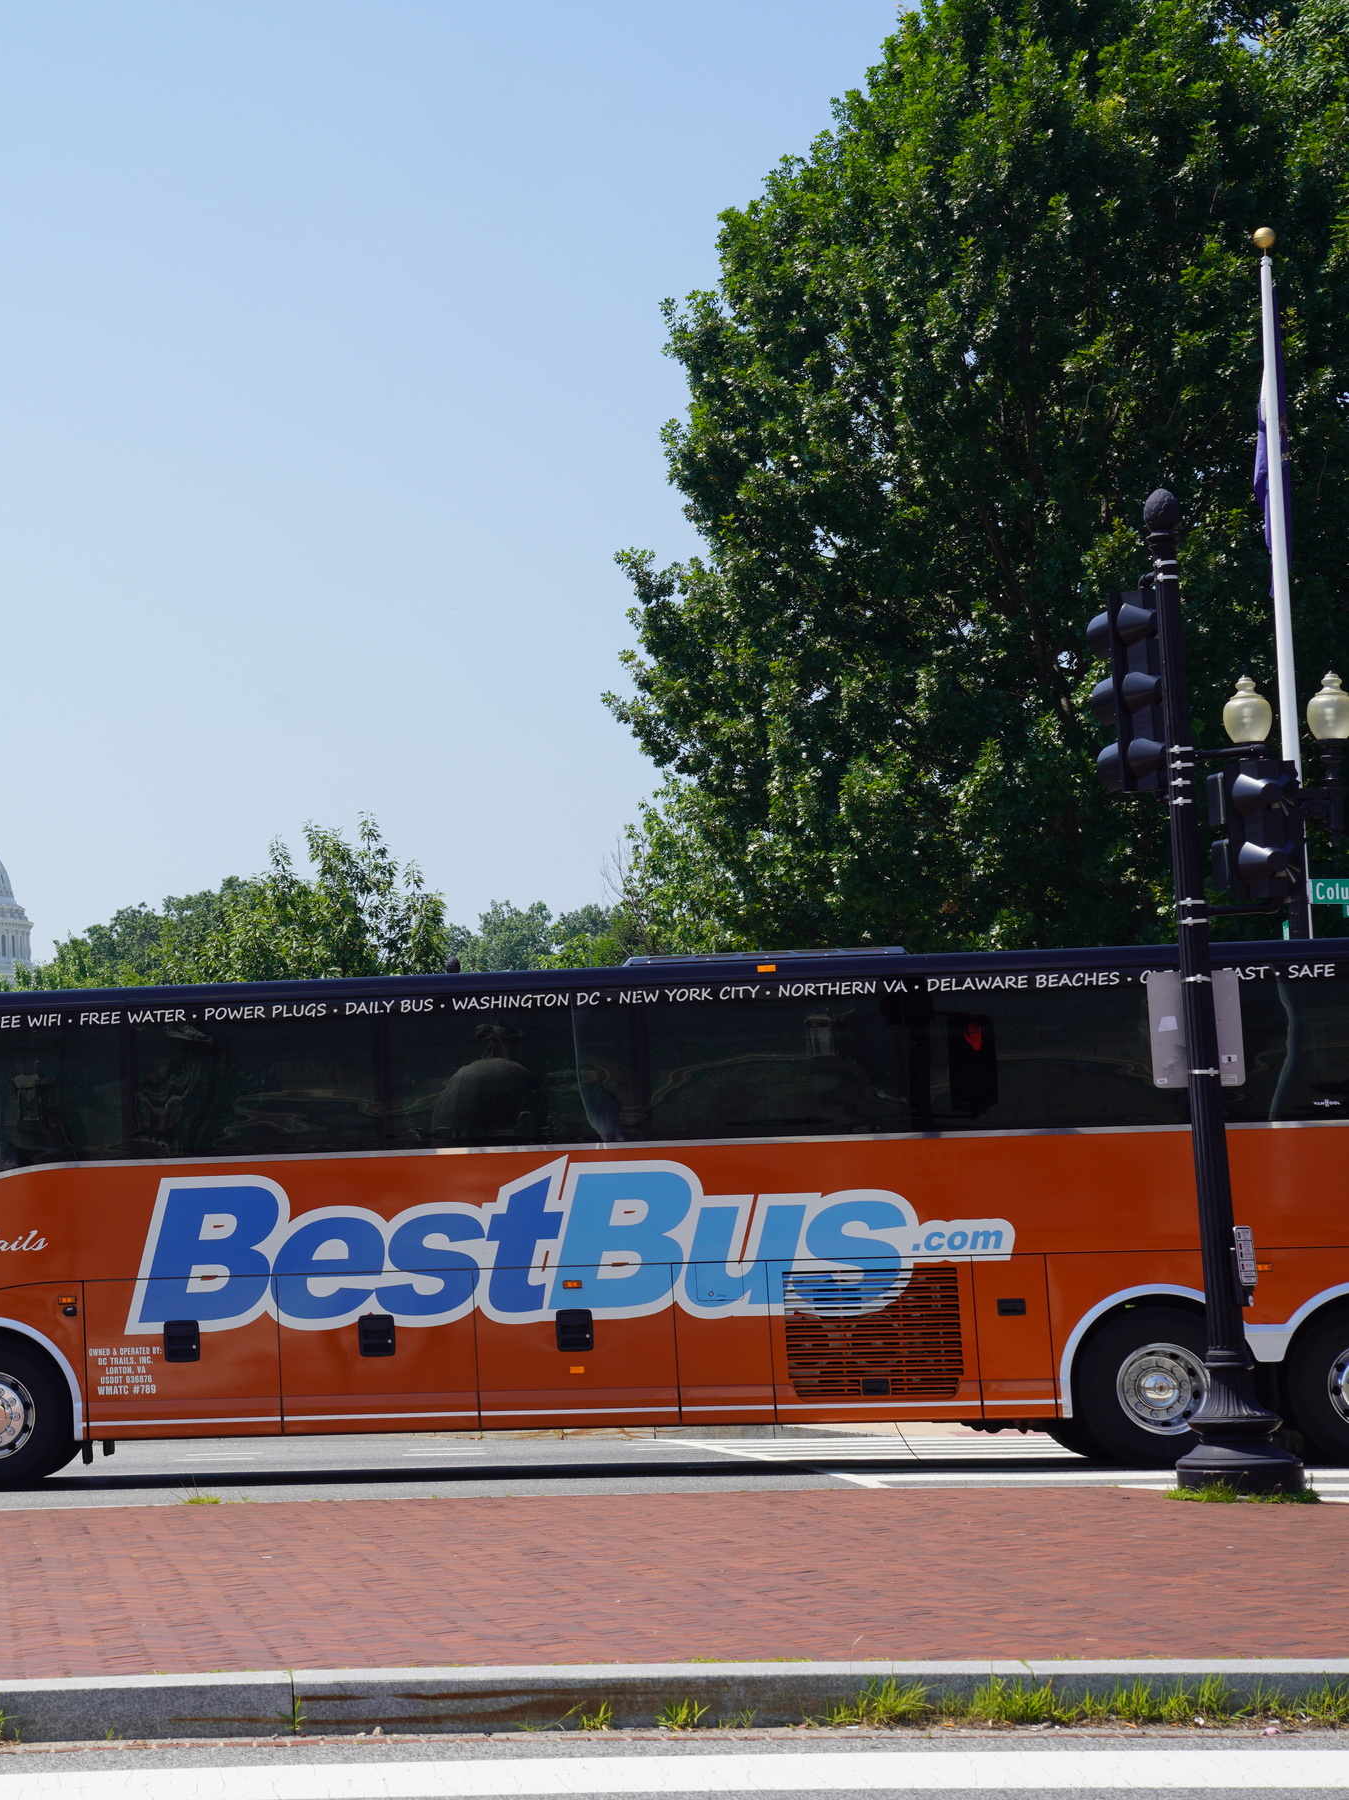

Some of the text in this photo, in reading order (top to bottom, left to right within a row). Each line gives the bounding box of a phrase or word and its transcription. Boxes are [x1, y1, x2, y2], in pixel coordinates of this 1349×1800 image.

[1223, 966, 1270, 981] AST
[1288, 963, 1336, 979] SAFE
[778, 979, 908, 997] NORTHERN VA
[926, 975, 1029, 992] DELAWARE
[1035, 971, 1120, 989] BEACHES
[452, 991, 601, 1011] WASHINGTON DC
[619, 985, 760, 1004] NEW YORK CITY
[204, 1003, 327, 1021] POWER PLUGS
[345, 998, 434, 1016] DAILY BUS
[27, 1013, 62, 1028] WIFI
[79, 1009, 187, 1026] FREE WATER
[88, 1346, 163, 1357] OWNED & OPERATED BY:
[97, 1357, 108, 1366] DC
[138, 1355, 155, 1365] INC.
[136, 1365, 147, 1375] VA
[100, 1374, 154, 1385] USDOT 936876
[97, 1383, 158, 1397] WMATC #789
